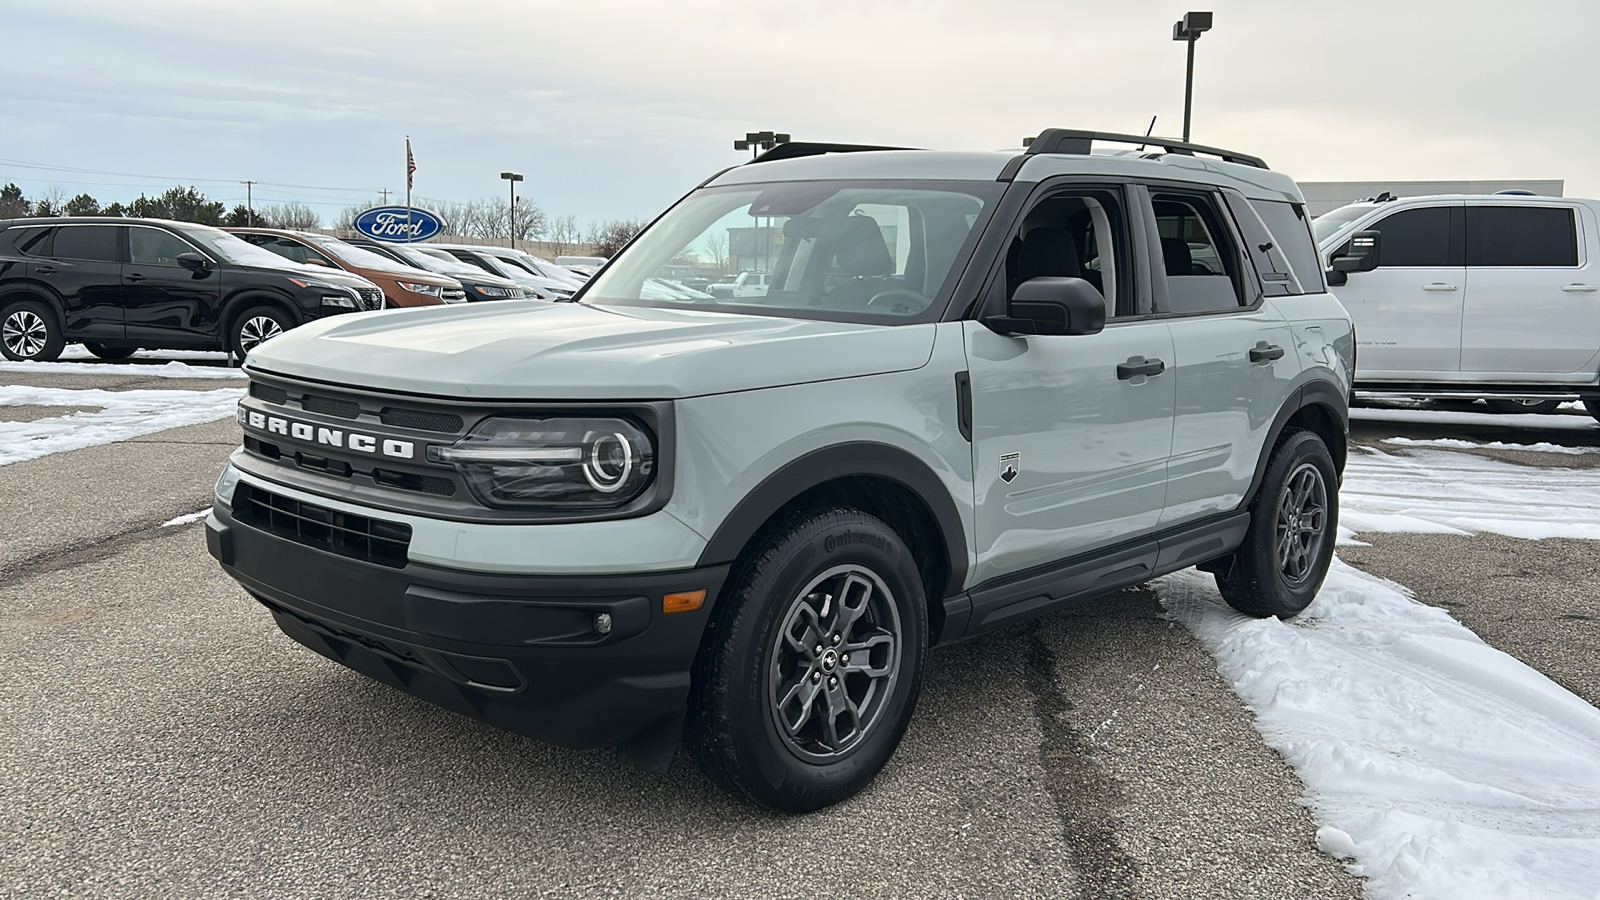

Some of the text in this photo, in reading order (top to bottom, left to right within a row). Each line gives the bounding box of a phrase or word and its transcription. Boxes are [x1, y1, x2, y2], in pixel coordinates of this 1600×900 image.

[371, 212, 423, 236] Ford
[249, 411, 414, 459] BRONCO
[823, 528, 886, 554] Continental
